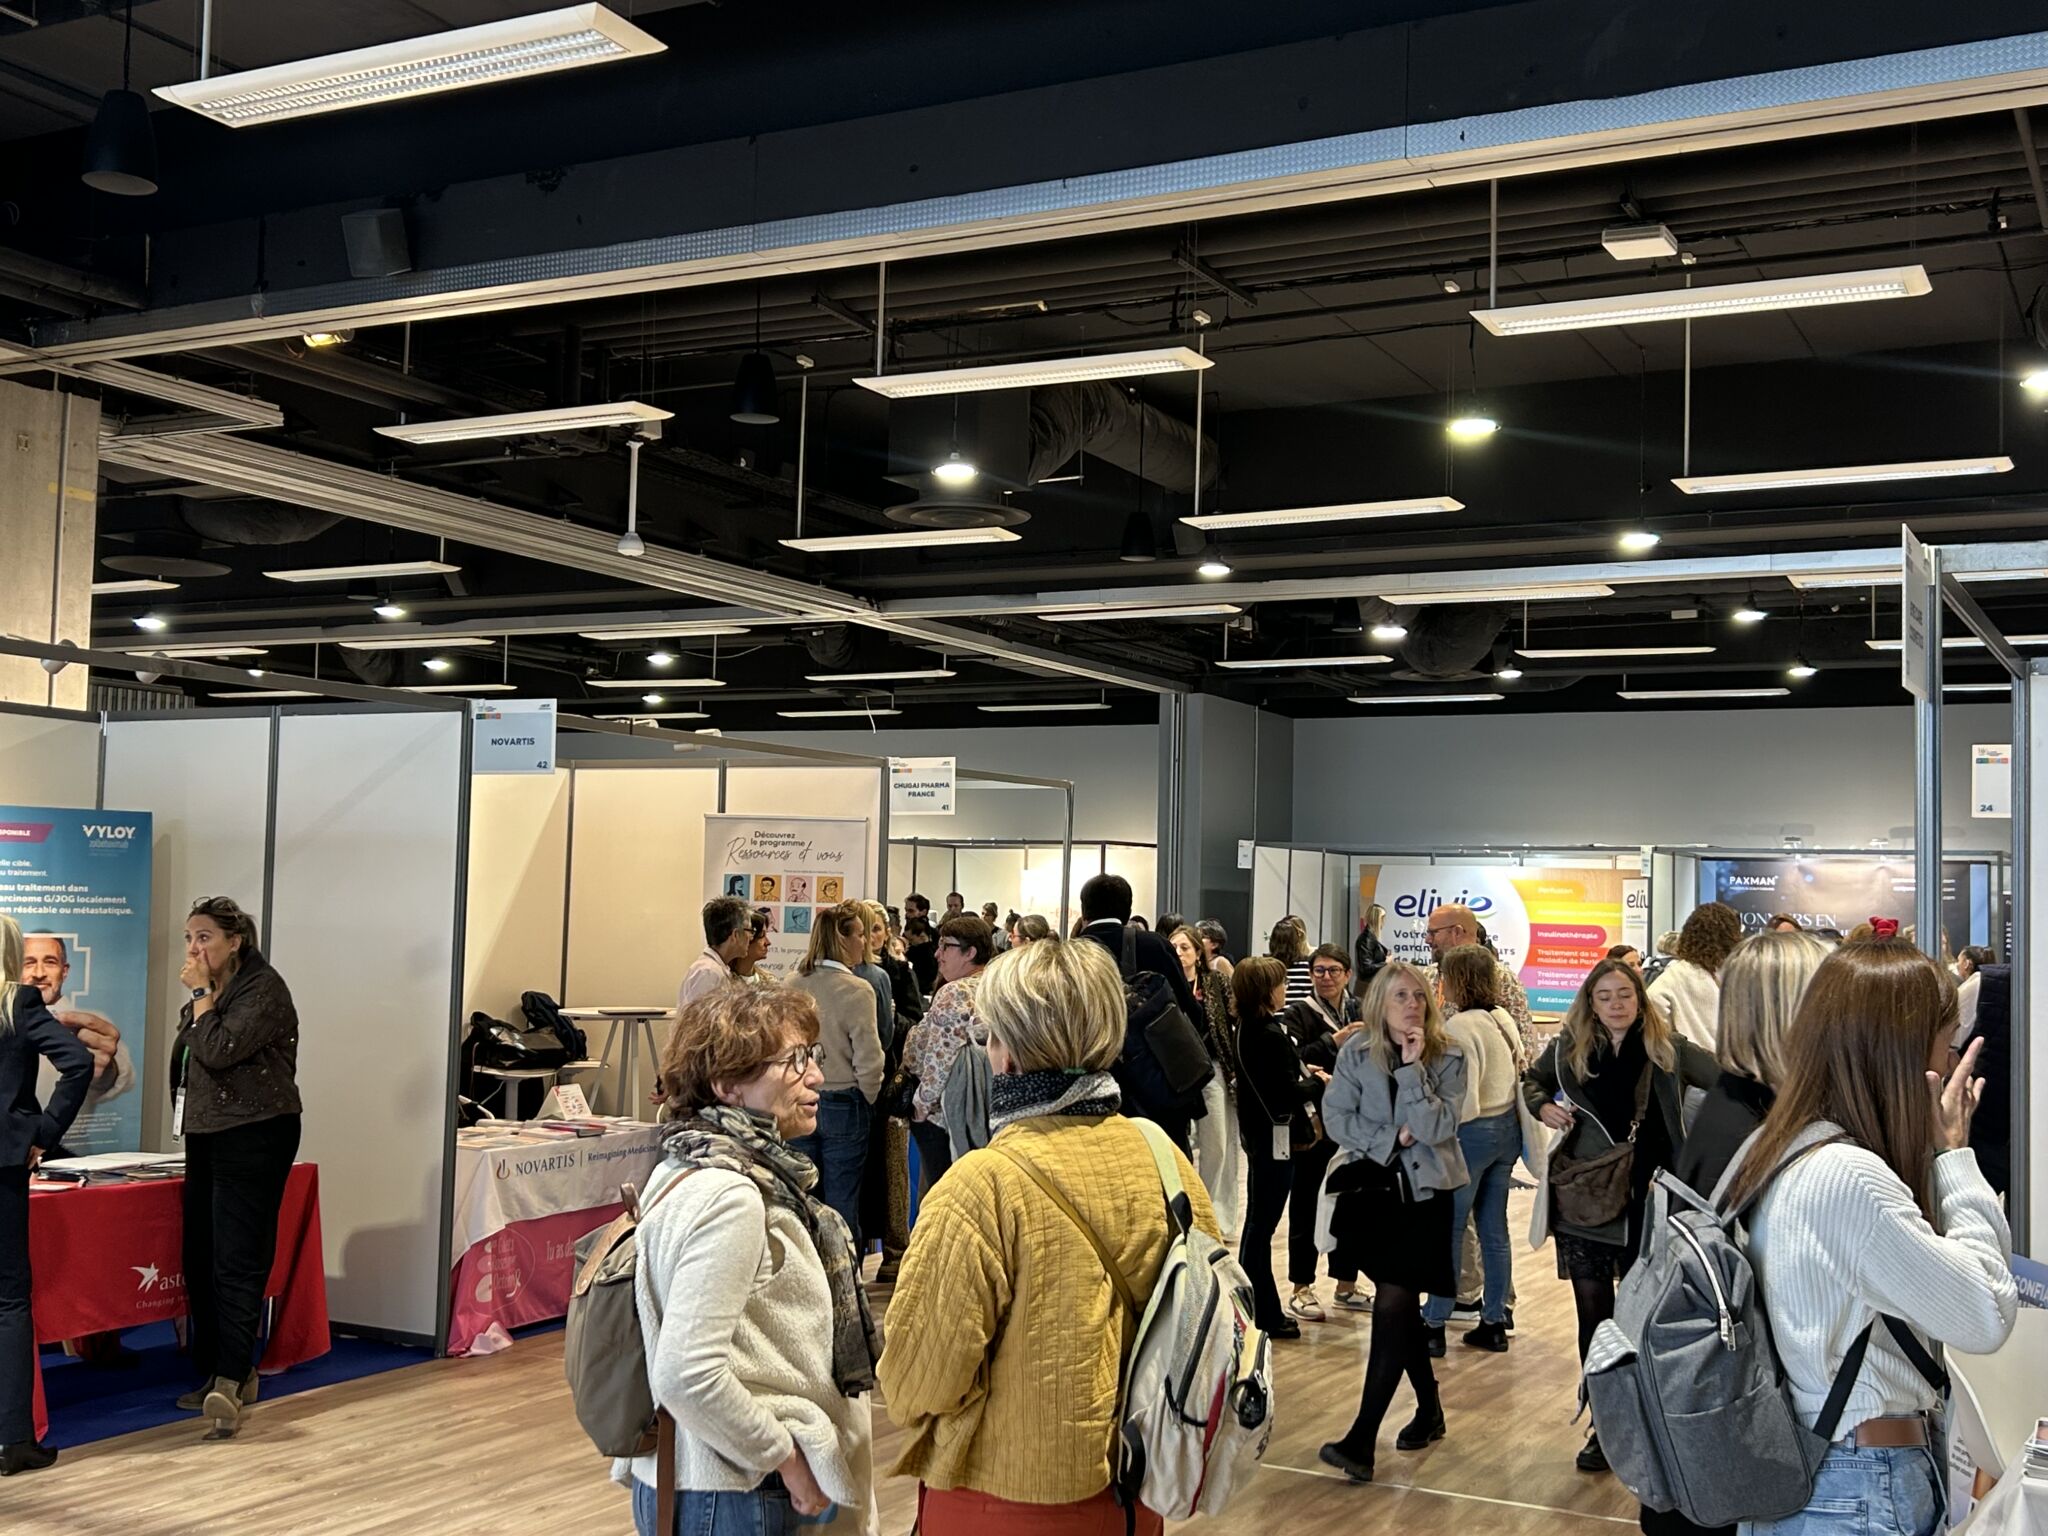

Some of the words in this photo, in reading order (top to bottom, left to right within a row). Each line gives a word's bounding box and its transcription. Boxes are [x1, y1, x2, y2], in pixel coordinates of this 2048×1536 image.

[491, 737, 535, 746] NOVARTIS
[536, 761, 548, 769] 42
[1980, 804, 1993, 812] 24
[82, 824, 136, 839] VYLOY
[754, 830, 796, 839] Découvrez
[750, 838, 758, 846] le
[760, 839, 806, 848] programme
[725, 836, 793, 867] Ressources
[798, 841, 814, 863] et
[816, 849, 844, 862] vous
[1729, 875, 1776, 886] PAXMAN
[17, 882, 67, 893] traitement
[67, 883, 89, 893] dans
[76, 895, 127, 904] localement
[13, 905, 58, 915] résécable
[59, 907, 72, 915] ou
[73, 906, 134, 916] métastatique.
[1815, 913, 1837, 928] EN
[1537, 949, 1578, 957] Traitement
[1537, 970, 1579, 978] Traitement
[515, 1153, 575, 1177] NOVARTIS
[587, 1147, 627, 1163] Reimagining
